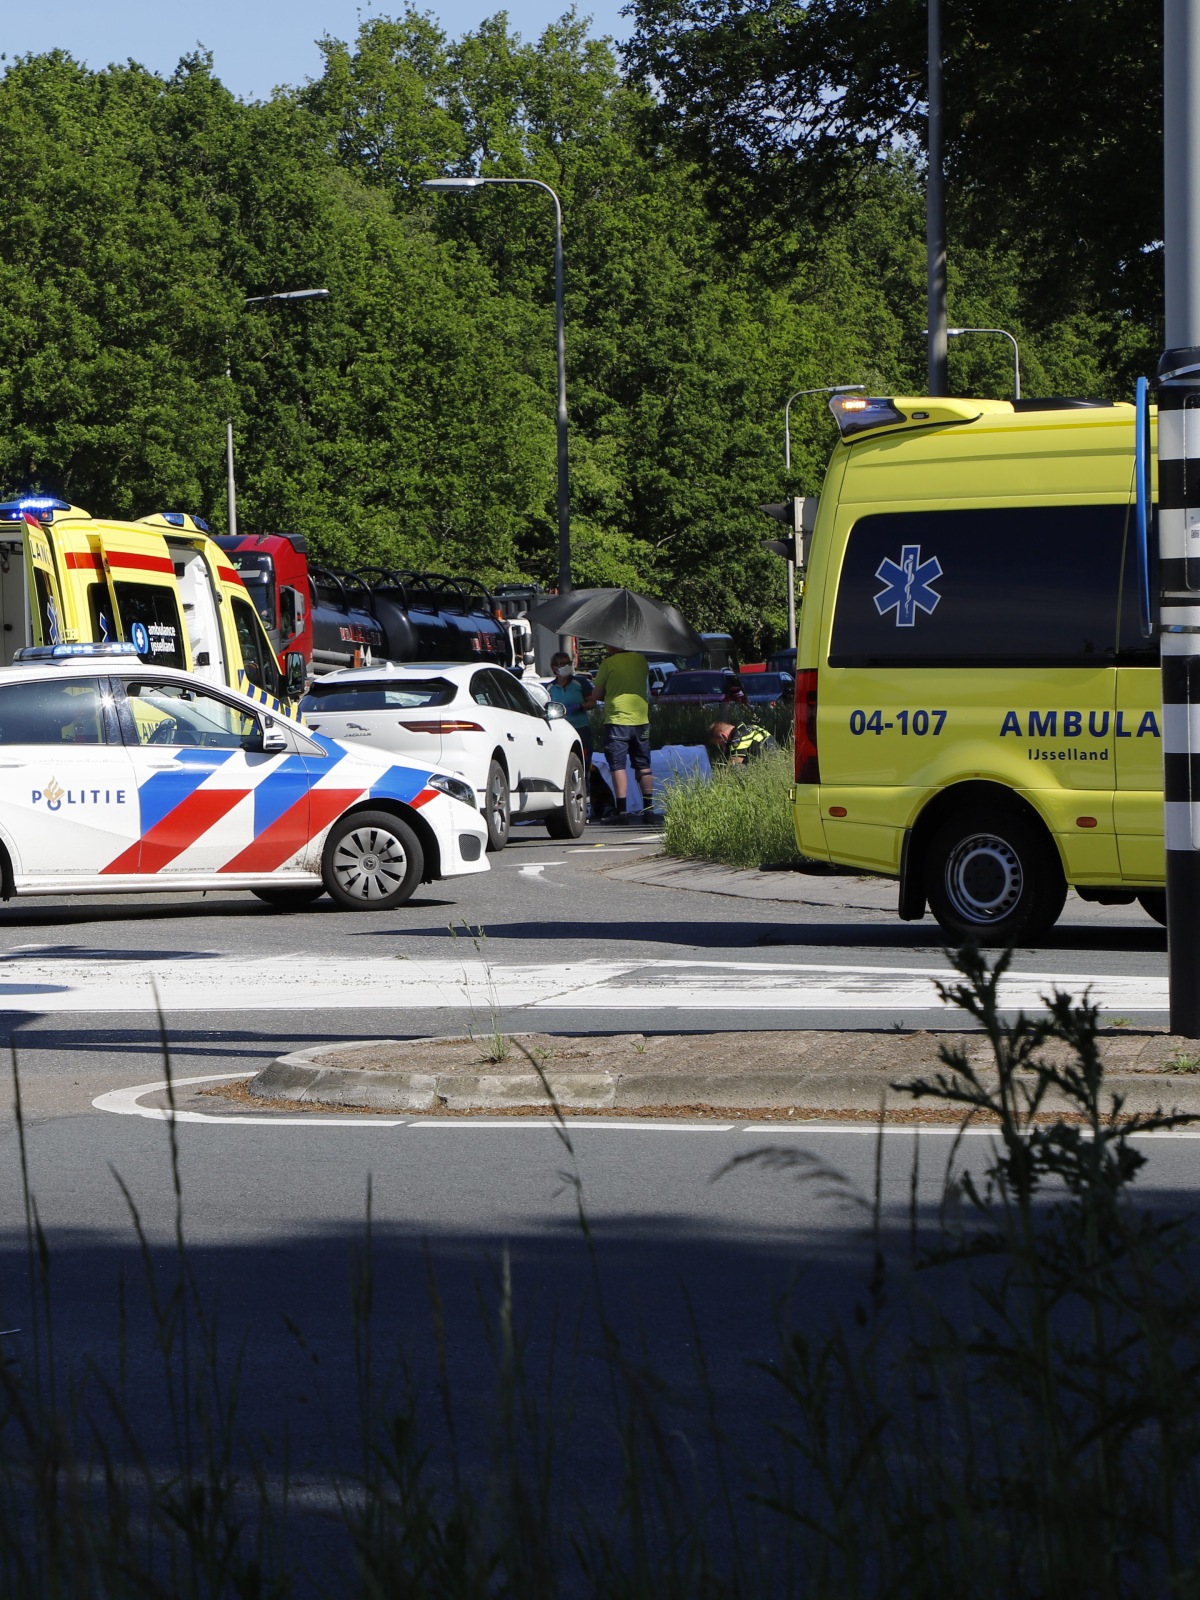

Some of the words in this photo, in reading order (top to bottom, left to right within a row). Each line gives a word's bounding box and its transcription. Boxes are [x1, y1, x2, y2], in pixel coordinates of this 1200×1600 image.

[148, 621, 176, 637] ambulance
[849, 709, 948, 736] 04-107
[999, 710, 1162, 738] AMBULA
[1028, 748, 1109, 761] IJsselland
[32, 789, 126, 811] POLITIE
